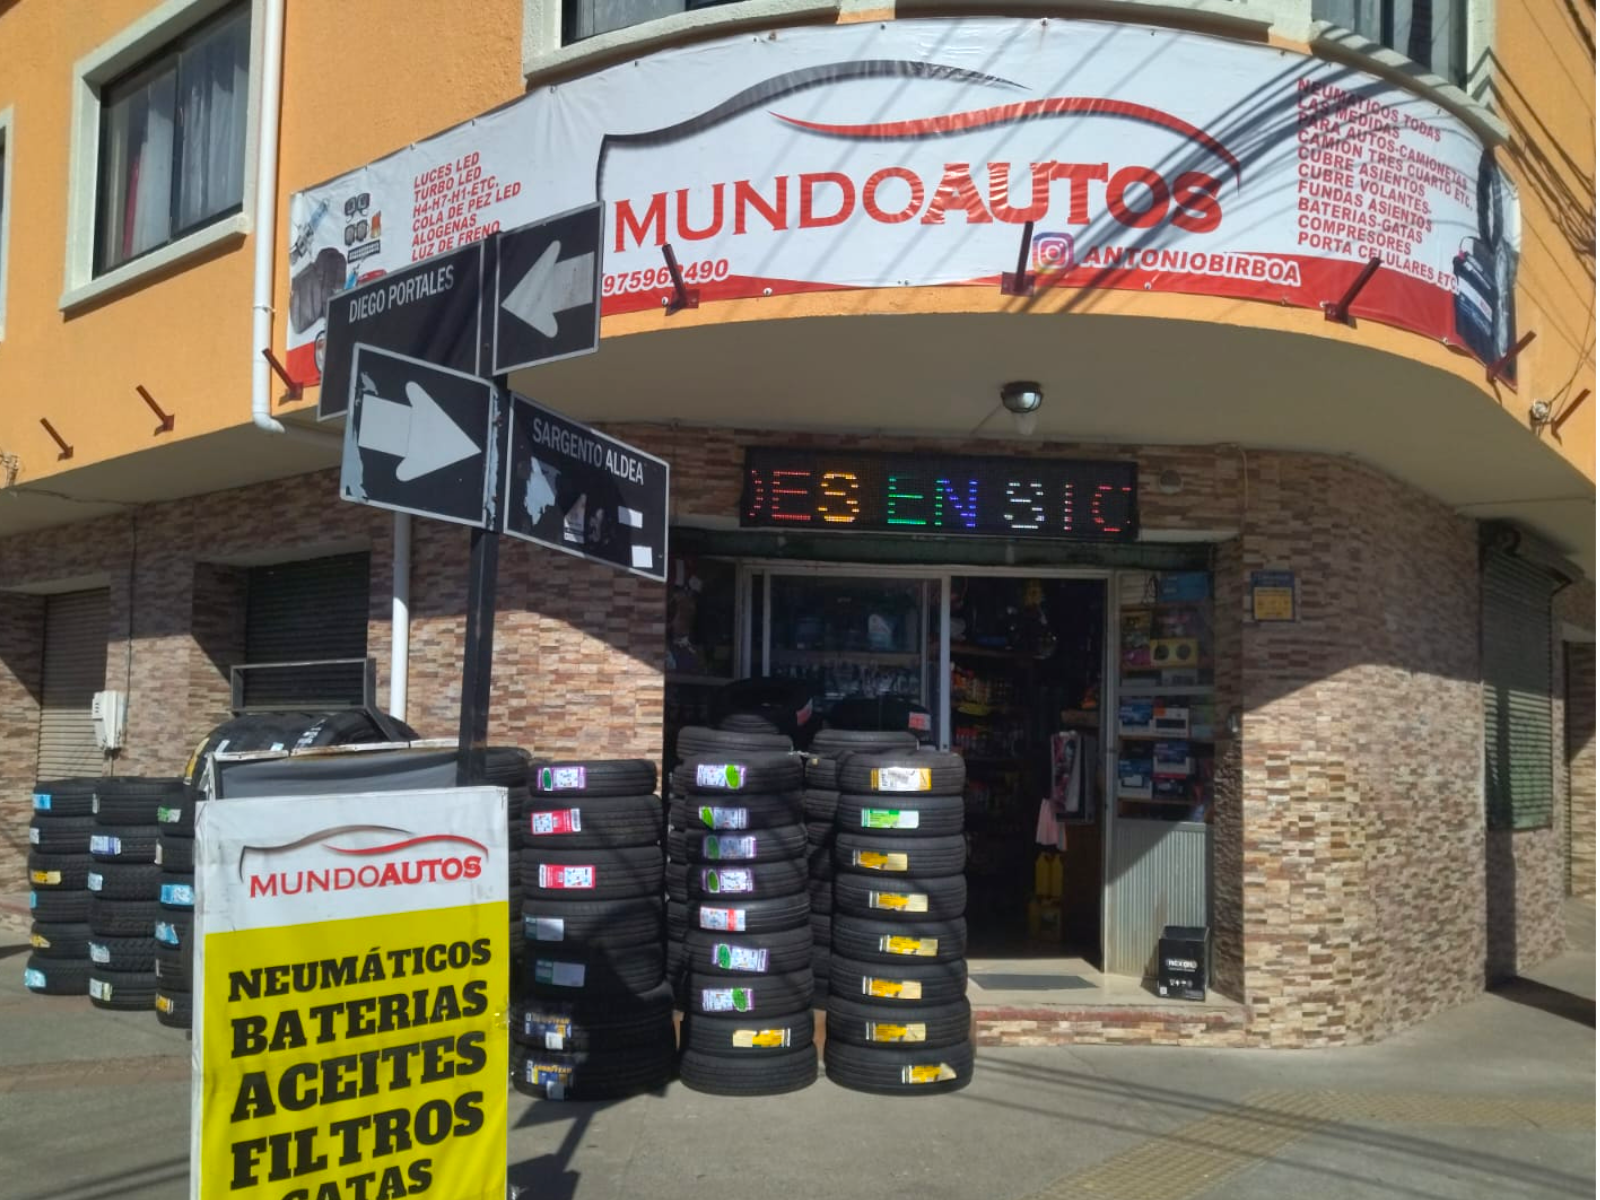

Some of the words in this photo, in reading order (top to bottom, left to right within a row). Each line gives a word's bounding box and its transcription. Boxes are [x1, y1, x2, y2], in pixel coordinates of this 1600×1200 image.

[1298, 96, 1329, 113] LAS
[1336, 106, 1400, 139] MEDIDAS
[1298, 111, 1340, 135] PARA
[1404, 114, 1441, 142] TODAS
[414, 163, 452, 189] LUCES
[456, 151, 480, 172] LED
[414, 177, 454, 203] TURBO
[458, 166, 481, 186] LED
[1298, 130, 1363, 158] CAMION
[1368, 148, 1403, 172] TRES
[1407, 165, 1451, 196] CUARTO
[1298, 146, 1354, 172] CUBRE
[1359, 163, 1425, 197] ASIENTOS
[1298, 163, 1354, 189] CUBRE
[412, 210, 443, 232] COLA
[447, 202, 464, 220] DE
[468, 192, 492, 213] PEZ
[495, 181, 522, 203] LED
[412, 213, 477, 247] ALOGENAS
[613, 159, 1223, 253] MUNDOAUTOS
[1298, 181, 1363, 207] FUNDAS
[1368, 198, 1432, 233] ASIENTOS
[411, 243, 435, 262] LUZ
[438, 236, 454, 253] DE
[458, 220, 500, 245] FRENO
[1298, 214, 1411, 255] COMPRESORES
[1298, 232, 1352, 255] PORTA
[1358, 245, 1434, 280] CELULARES
[1083, 246, 1300, 285] ANTONIOBIRBOA
[349, 287, 386, 323] DIEGO
[388, 263, 455, 308] PORTALES
[532, 417, 603, 468] SARGENTO
[605, 449, 644, 486] ALDEA
[888, 476, 978, 528] EN
[249, 855, 483, 899] MUNDOAUTOS
[228, 938, 492, 1003] NEUMÁTICOS
[230, 980, 489, 1059] BATERIAS
[230, 1030, 488, 1124] ACEITES
[230, 1091, 485, 1191] FILTROS
